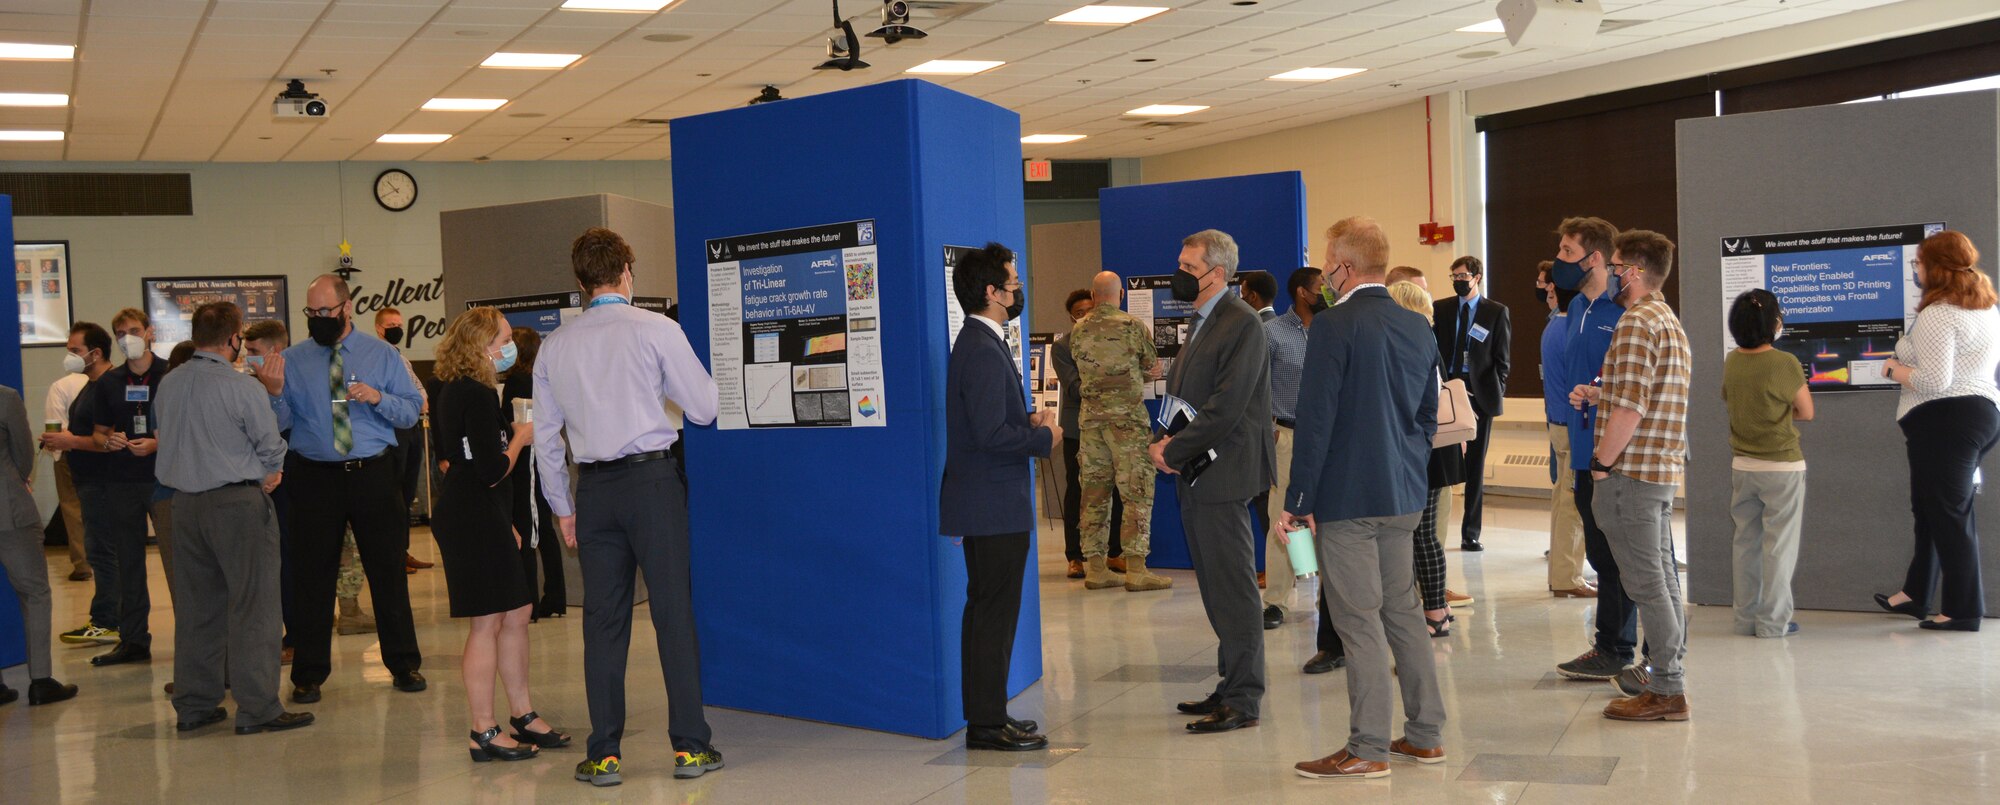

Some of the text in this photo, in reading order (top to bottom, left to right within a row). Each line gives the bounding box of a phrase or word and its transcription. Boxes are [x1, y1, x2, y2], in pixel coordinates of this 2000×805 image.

[1030, 161, 1049, 177] EXIT
[737, 232, 841, 252] We invent the stuff that makes the future!
[1765, 232, 1903, 248] We invent the stuff that makes the future!
[810, 259, 834, 269] AFRL
[1862, 254, 1892, 262] AFRL
[742, 264, 783, 276] Investigation
[1771, 262, 1831, 272] New Frontiers:
[172, 281, 197, 289] Annual
[237, 280, 274, 288] Recipients
[744, 280, 751, 290] of
[752, 278, 786, 290] Tri-Linear
[1771, 272, 1854, 285] Complexity Enabled
[1772, 280, 1891, 296] Capabilities from 3D Printing
[744, 289, 828, 307] fatigue crack growth rate
[1782, 293, 1832, 306] Composites
[1833, 292, 1846, 301] via
[1848, 291, 1878, 300] Frontal
[745, 308, 776, 319] behavior
[776, 307, 783, 316] in
[1782, 305, 1834, 316] lymerization
[406, 315, 446, 348] Peo
